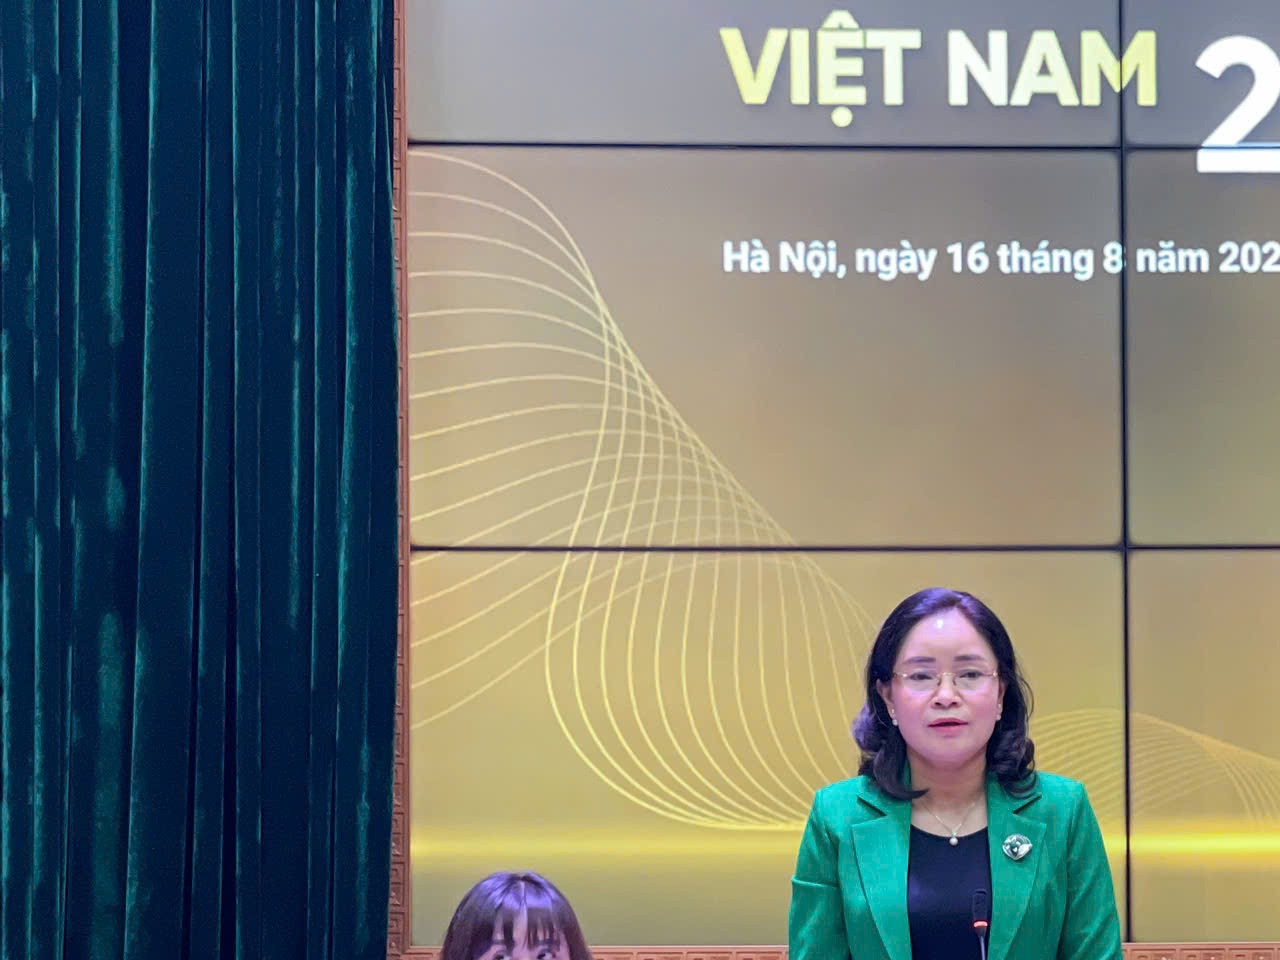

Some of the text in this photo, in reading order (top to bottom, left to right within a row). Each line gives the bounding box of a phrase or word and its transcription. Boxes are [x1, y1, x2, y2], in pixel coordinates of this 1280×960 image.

[719, 9, 922, 128] VIỆT
[947, 29, 1157, 107] NAM
[722, 238, 771, 274] Hà
[778, 239, 847, 280] Nội,
[855, 239, 938, 282] ngày
[945, 240, 990, 275] 16
[996, 239, 1094, 282] tháng
[1102, 240, 1127, 275] 8
[1135, 239, 1210, 274] năm
